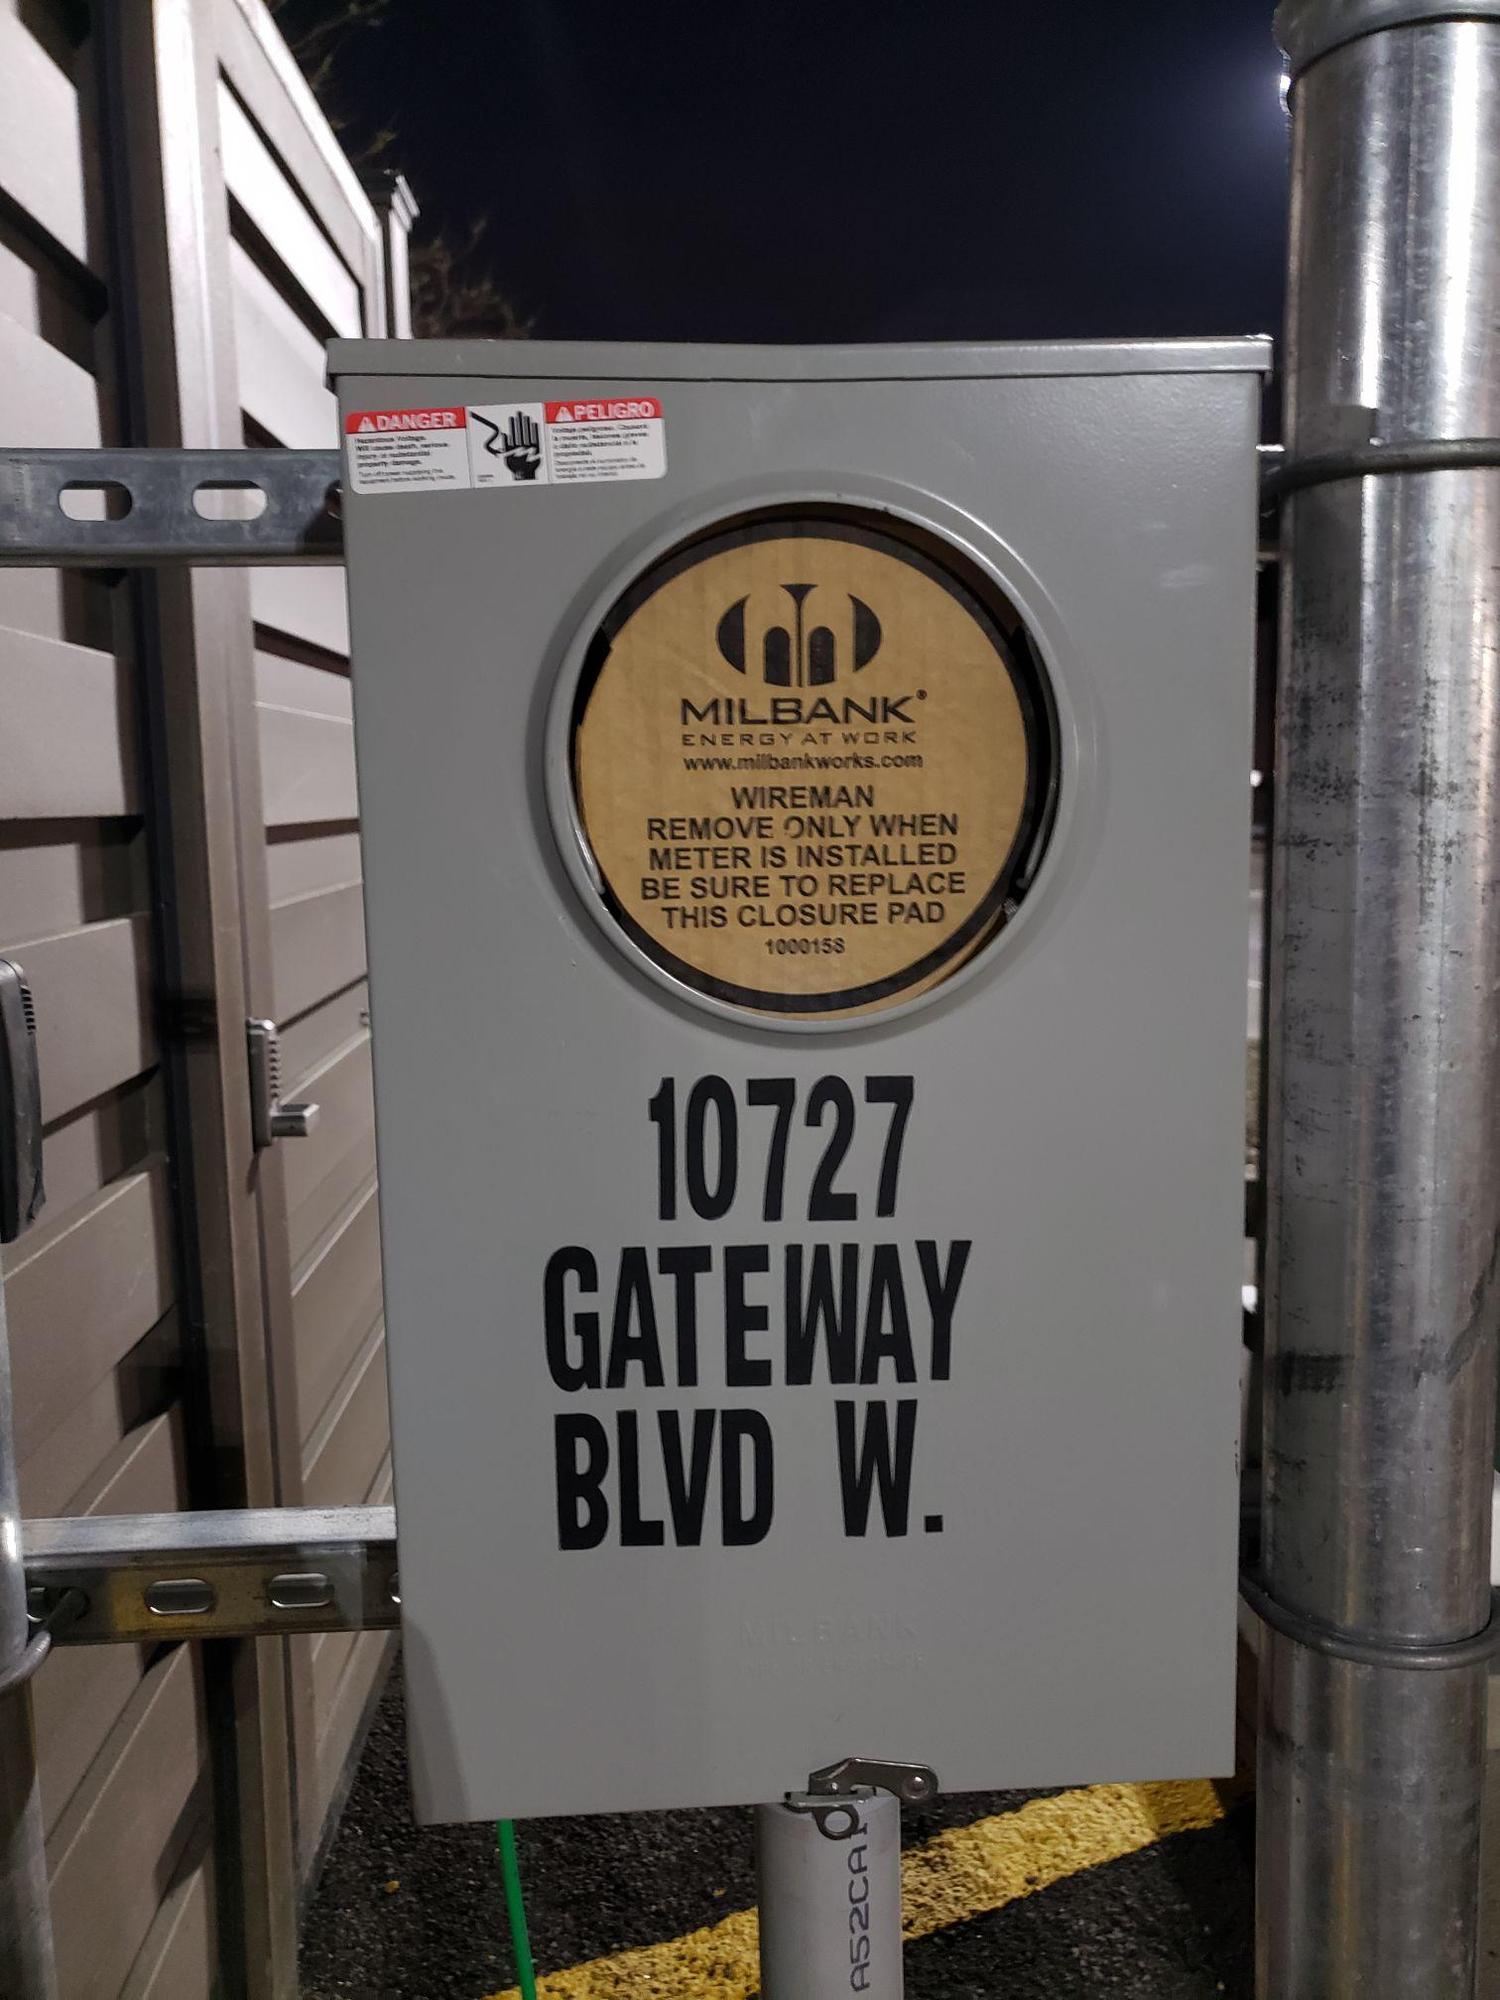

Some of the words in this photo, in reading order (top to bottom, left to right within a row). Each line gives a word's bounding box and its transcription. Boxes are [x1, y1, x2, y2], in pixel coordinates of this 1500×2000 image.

[377, 412, 456, 430] DANGER
[574, 401, 655, 420] PELIGRO
[683, 733, 793, 746] ENERGY
[801, 733, 830, 744] AT
[842, 731, 916, 744] WORK
[684, 753, 923, 770] www.milbankworks.com
[732, 785, 874, 808] WIREMAN
[647, 816, 773, 840] REMOVE
[784, 815, 861, 838] ONLY
[869, 814, 958, 836] WHEN
[650, 847, 751, 870] METER
[762, 846, 786, 868] IS
[797, 844, 957, 867] INSTALLED
[641, 878, 680, 899] BE
[690, 876, 770, 899] SURE
[779, 875, 818, 897] TO
[830, 872, 965, 895] REPLACE
[662, 906, 727, 928] THIS
[737, 903, 877, 927] CLOSURE
[887, 902, 945, 924] PAD
[648, 1074, 914, 1221] 10727
[543, 1240, 972, 1391] GATEWAY
[554, 1408, 774, 1550] BLVD
[834, 1399, 943, 1537] W.
